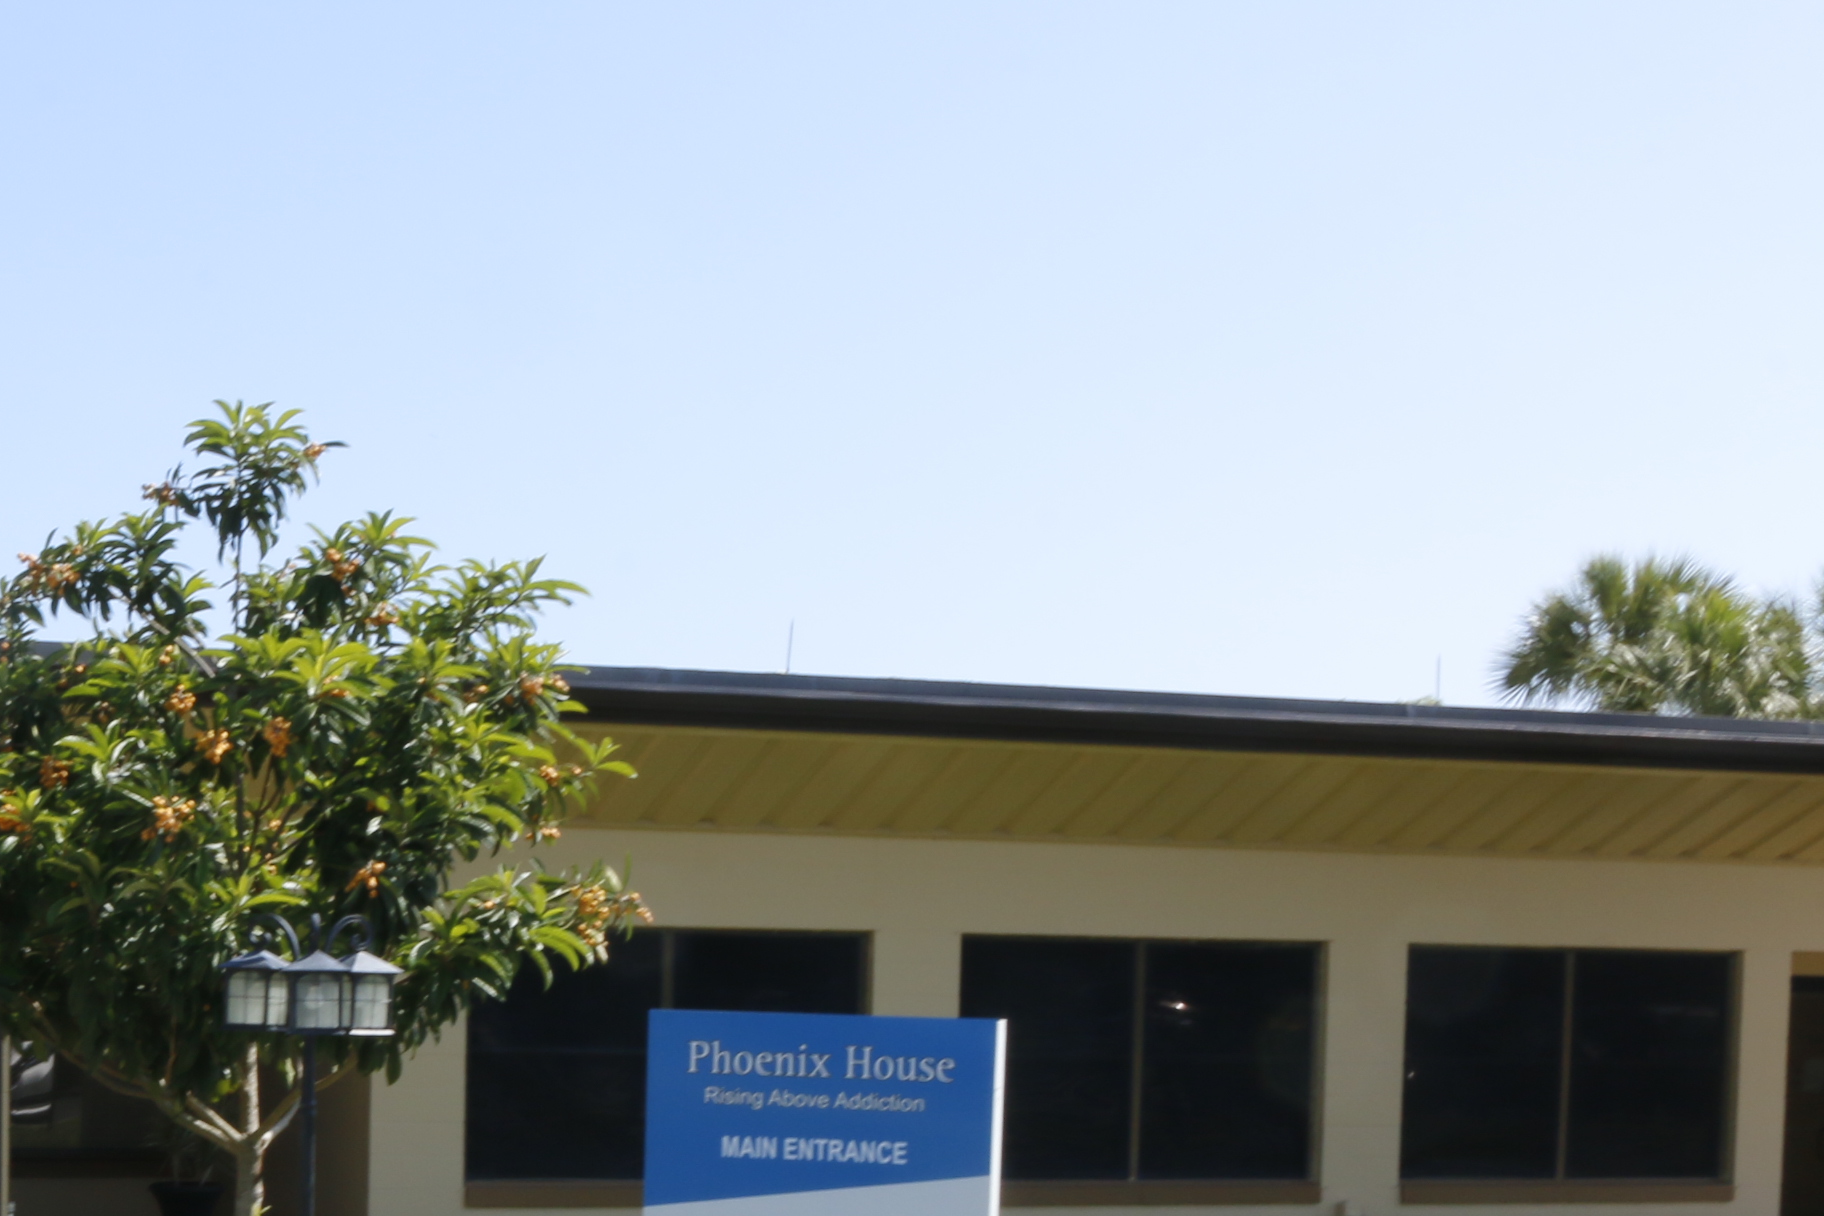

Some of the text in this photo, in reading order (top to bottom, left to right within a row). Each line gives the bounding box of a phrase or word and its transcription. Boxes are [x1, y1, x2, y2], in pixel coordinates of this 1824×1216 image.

[687, 1039, 956, 1084] Phoenix House
[704, 1085, 926, 1113] Rising Above Addiction
[720, 1135, 909, 1165] MAIN ENTRANCE
